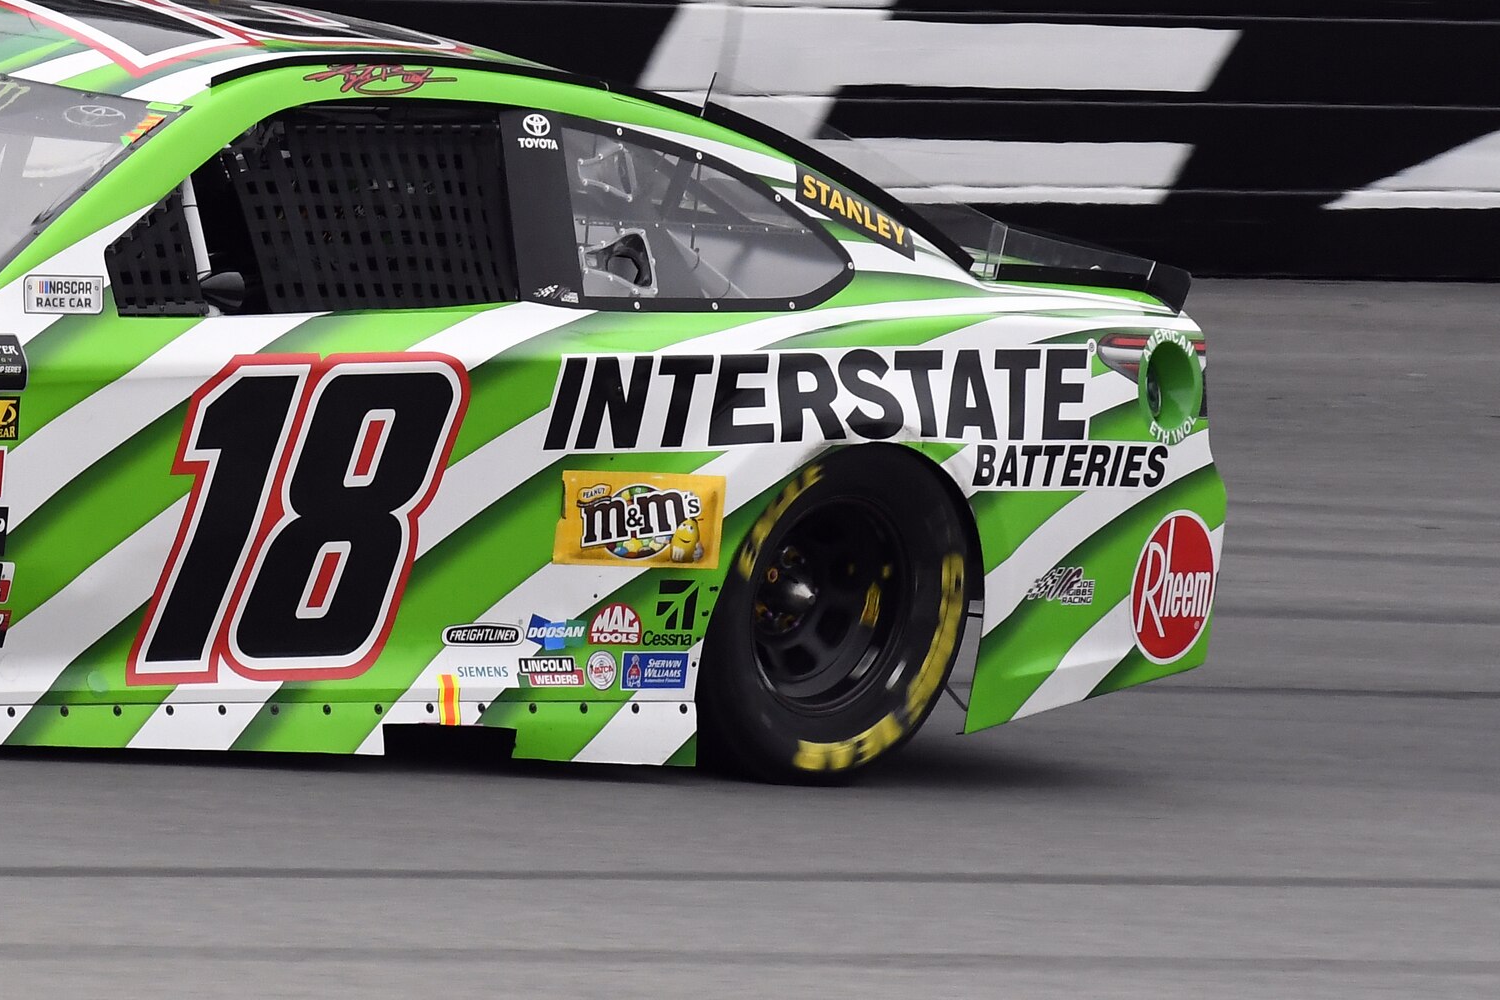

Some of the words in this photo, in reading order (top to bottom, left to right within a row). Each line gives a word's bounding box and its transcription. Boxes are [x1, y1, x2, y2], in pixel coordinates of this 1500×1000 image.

[517, 137, 559, 151] TOYOTA
[803, 174, 905, 245] STANLEY
[49, 281, 92, 295] NASCAR
[36, 297, 65, 308] RACE
[69, 298, 92, 308] CAR
[1143, 329, 1195, 362] AMERICAN
[543, 348, 1088, 451] INTERSTATE
[972, 445, 1169, 487] BATTERIES
[582, 487, 607, 500] PEANUT
[135, 361, 462, 675] 18
[1076, 580, 1095, 588] JOE
[1137, 517, 1211, 638] Rheem
[1061, 596, 1093, 604] RACING
[449, 628, 516, 641] FREIGHTLINER
[527, 626, 585, 638] DOOSAN
[591, 632, 639, 644] TOOLS
[642, 630, 692, 647] Cessna
[521, 658, 572, 672] LINCOLN
[647, 658, 682, 668] SHERWIN
[457, 665, 509, 678] SIEMENS
[644, 668, 682, 678] WILLIAMS
[534, 674, 579, 685] WELDERS
